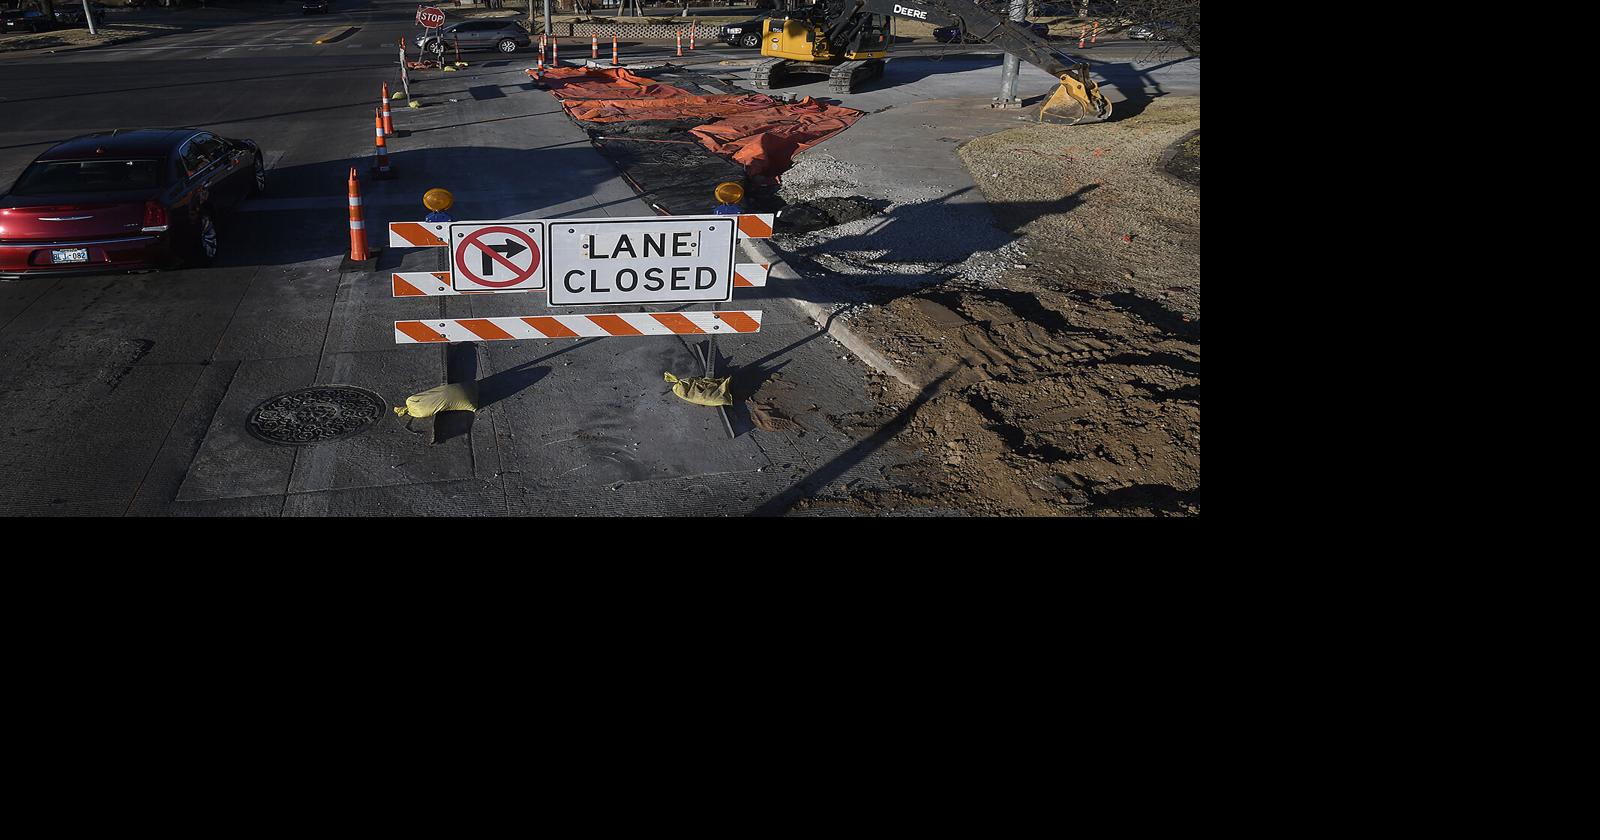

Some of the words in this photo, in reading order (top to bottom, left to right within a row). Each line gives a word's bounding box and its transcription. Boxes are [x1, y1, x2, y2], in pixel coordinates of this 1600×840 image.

[420, 12, 444, 23] STOP
[893, 4, 927, 20] DEERE
[589, 232, 692, 259] LANE
[563, 266, 718, 294] CLOSED
